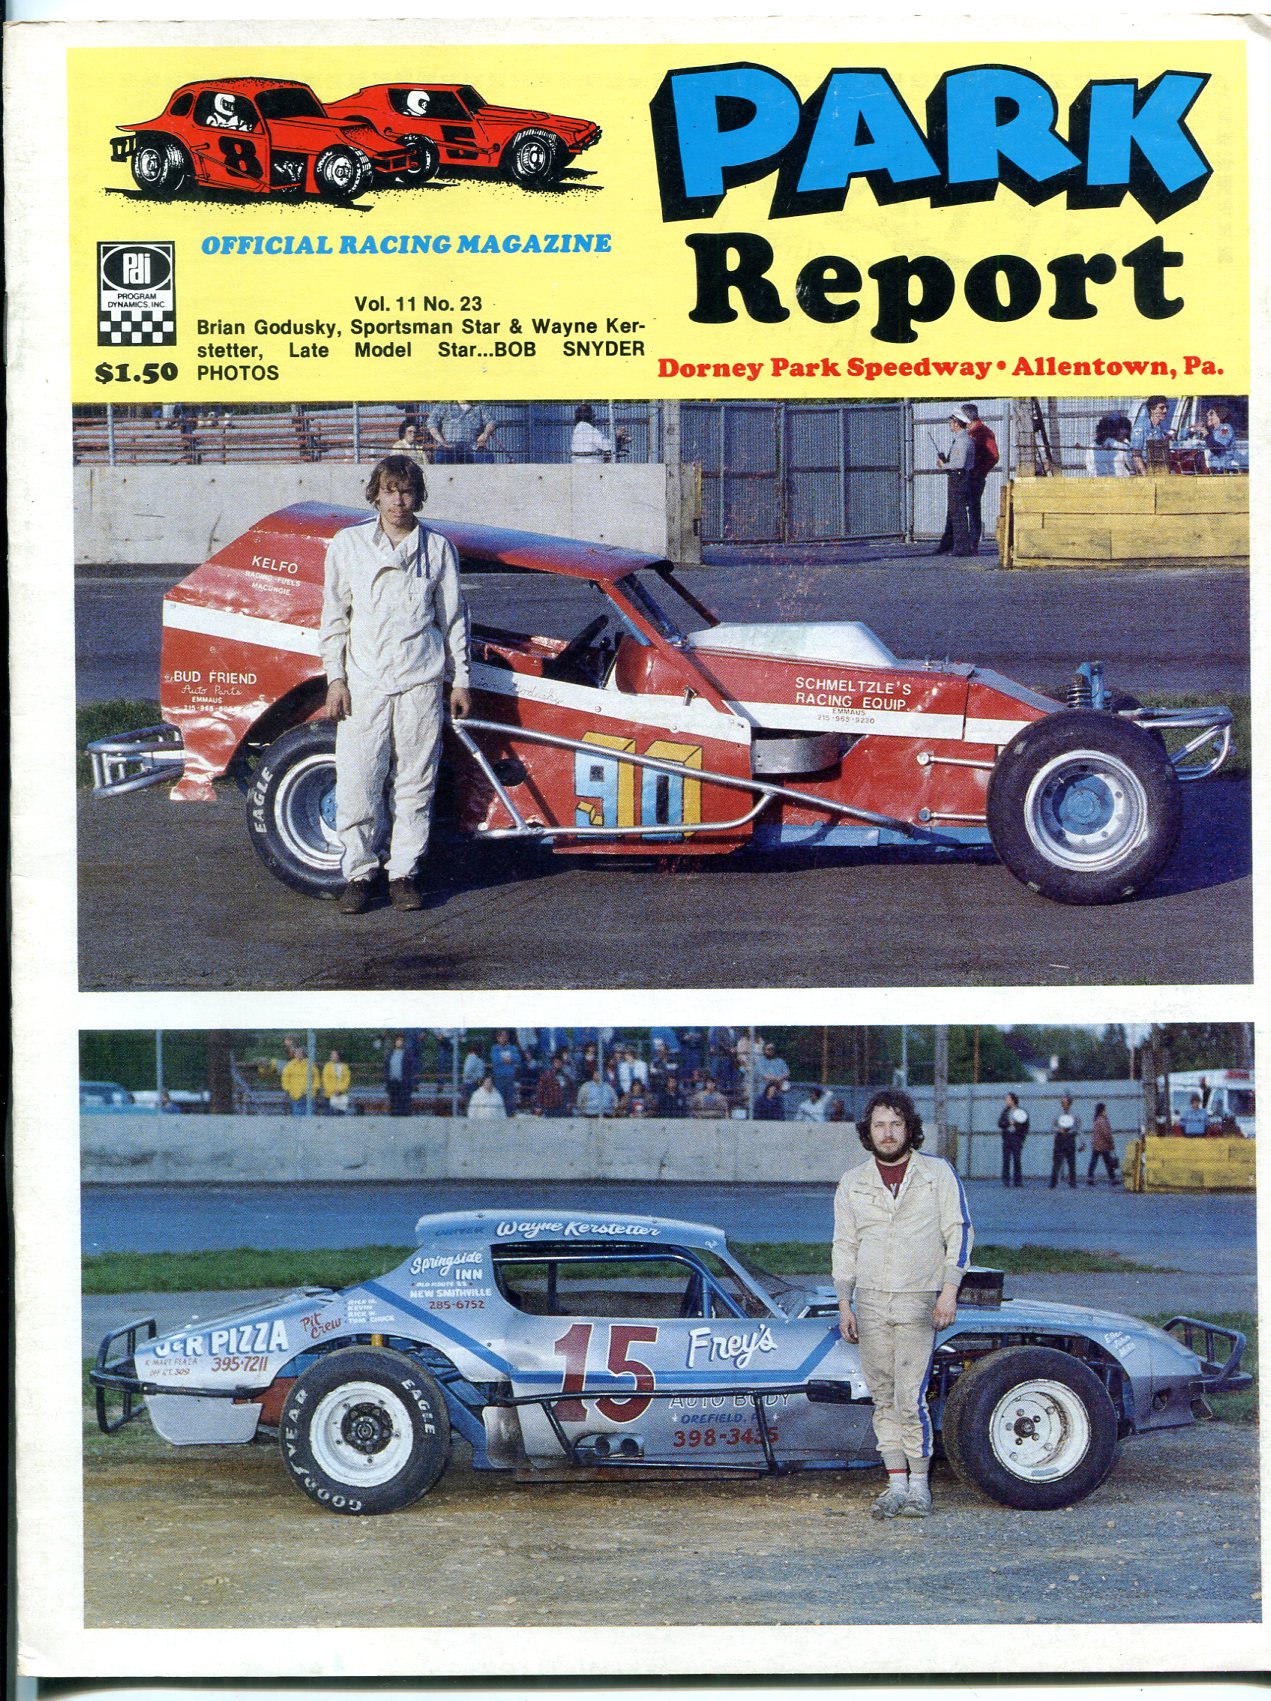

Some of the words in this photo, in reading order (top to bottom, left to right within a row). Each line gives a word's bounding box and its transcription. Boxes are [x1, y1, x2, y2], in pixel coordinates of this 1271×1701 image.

[650, 62, 1213, 223] PARK
[218, 135, 263, 177] 8
[201, 235, 333, 255] OFFICIAL
[339, 235, 451, 254] RACING
[457, 233, 612, 253] MAGAZINE
[117, 292, 157, 300] PROGRAM
[685, 231, 1185, 344] Report
[107, 301, 151, 309] DYNAMICS,
[354, 295, 391, 312] Vol.
[396, 296, 416, 312] 11
[424, 296, 454, 311] No.
[460, 295, 483, 311] 23
[197, 319, 245, 335] Brian
[254, 319, 342, 338] Godusky,
[350, 318, 453, 338] Sportsman
[462, 318, 500, 334] Star
[509, 319, 523, 334] &
[532, 318, 598, 337] Wayne
[606, 317, 646, 333] Ker-
[197, 343, 263, 360] stetter,
[289, 342, 329, 358] Late
[355, 341, 411, 357] Model
[563, 340, 645, 356] SNYDER
[95, 361, 178, 385] $1.50
[197, 365, 280, 381] PHOTOS
[657, 358, 764, 381] Dorney
[770, 357, 841, 377] Park
[847, 357, 992, 380] Speedway
[1012, 356, 1177, 379] Allentown,
[1183, 356, 1224, 375] Pa.
[251, 555, 298, 574] KELFO
[174, 671, 201, 682] BUD
[209, 671, 257, 685] FRIEND
[795, 677, 911, 695] SCHMELTZLE'S
[796, 694, 852, 707] RACING
[863, 697, 910, 712] EQUIP.
[832, 708, 866, 716] EMMAUS
[574, 731, 702, 842] 90
[252, 767, 274, 834] EAGLE
[496, 1221, 563, 1239] Wayne
[563, 1221, 662, 1238] Kerstetter
[409, 1250, 483, 1277] Springside
[455, 1268, 483, 1280] INN
[410, 1289, 434, 1298] NEW
[436, 1288, 492, 1298] SMITHVILLE
[429, 1300, 485, 1310] 285-6752
[300, 1312, 321, 1332] Pit
[310, 1317, 341, 1338] Crew
[209, 1319, 289, 1356] PIZZA
[685, 1324, 779, 1370] Frey's
[553, 1323, 660, 1424] 15
[401, 1378, 437, 1435] EAGLE
[667, 1394, 726, 1409] AUTO
